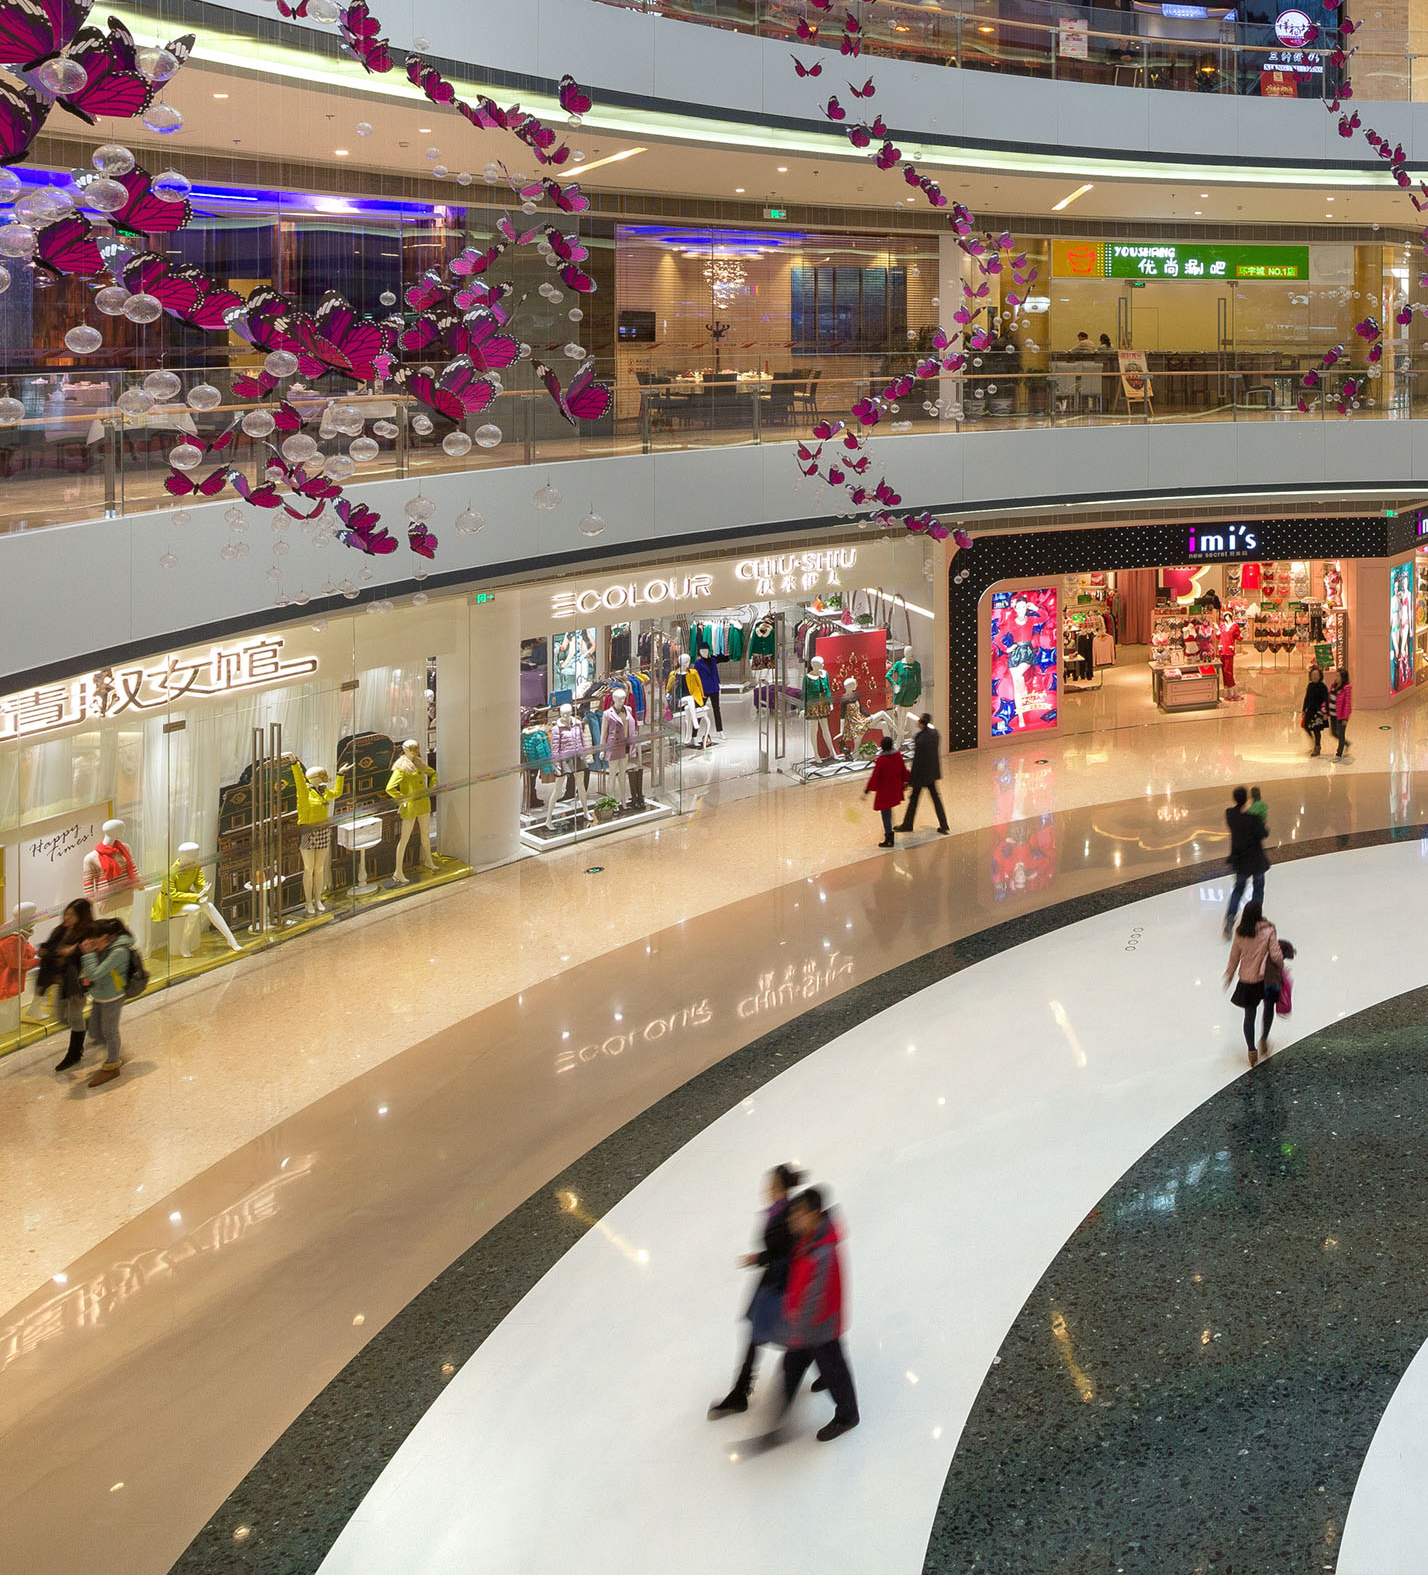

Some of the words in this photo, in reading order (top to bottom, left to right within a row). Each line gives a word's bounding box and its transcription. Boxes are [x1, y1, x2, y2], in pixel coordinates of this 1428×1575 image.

[1114, 246, 1176, 257] YOUSHANG
[1137, 257, 1227, 277] 优尚涮吧
[1189, 525, 1257, 552] imi's
[551, 574, 713, 618] ECOLOUR
[29, 824, 81, 857] Happy
[47, 825, 94, 862] Times!
